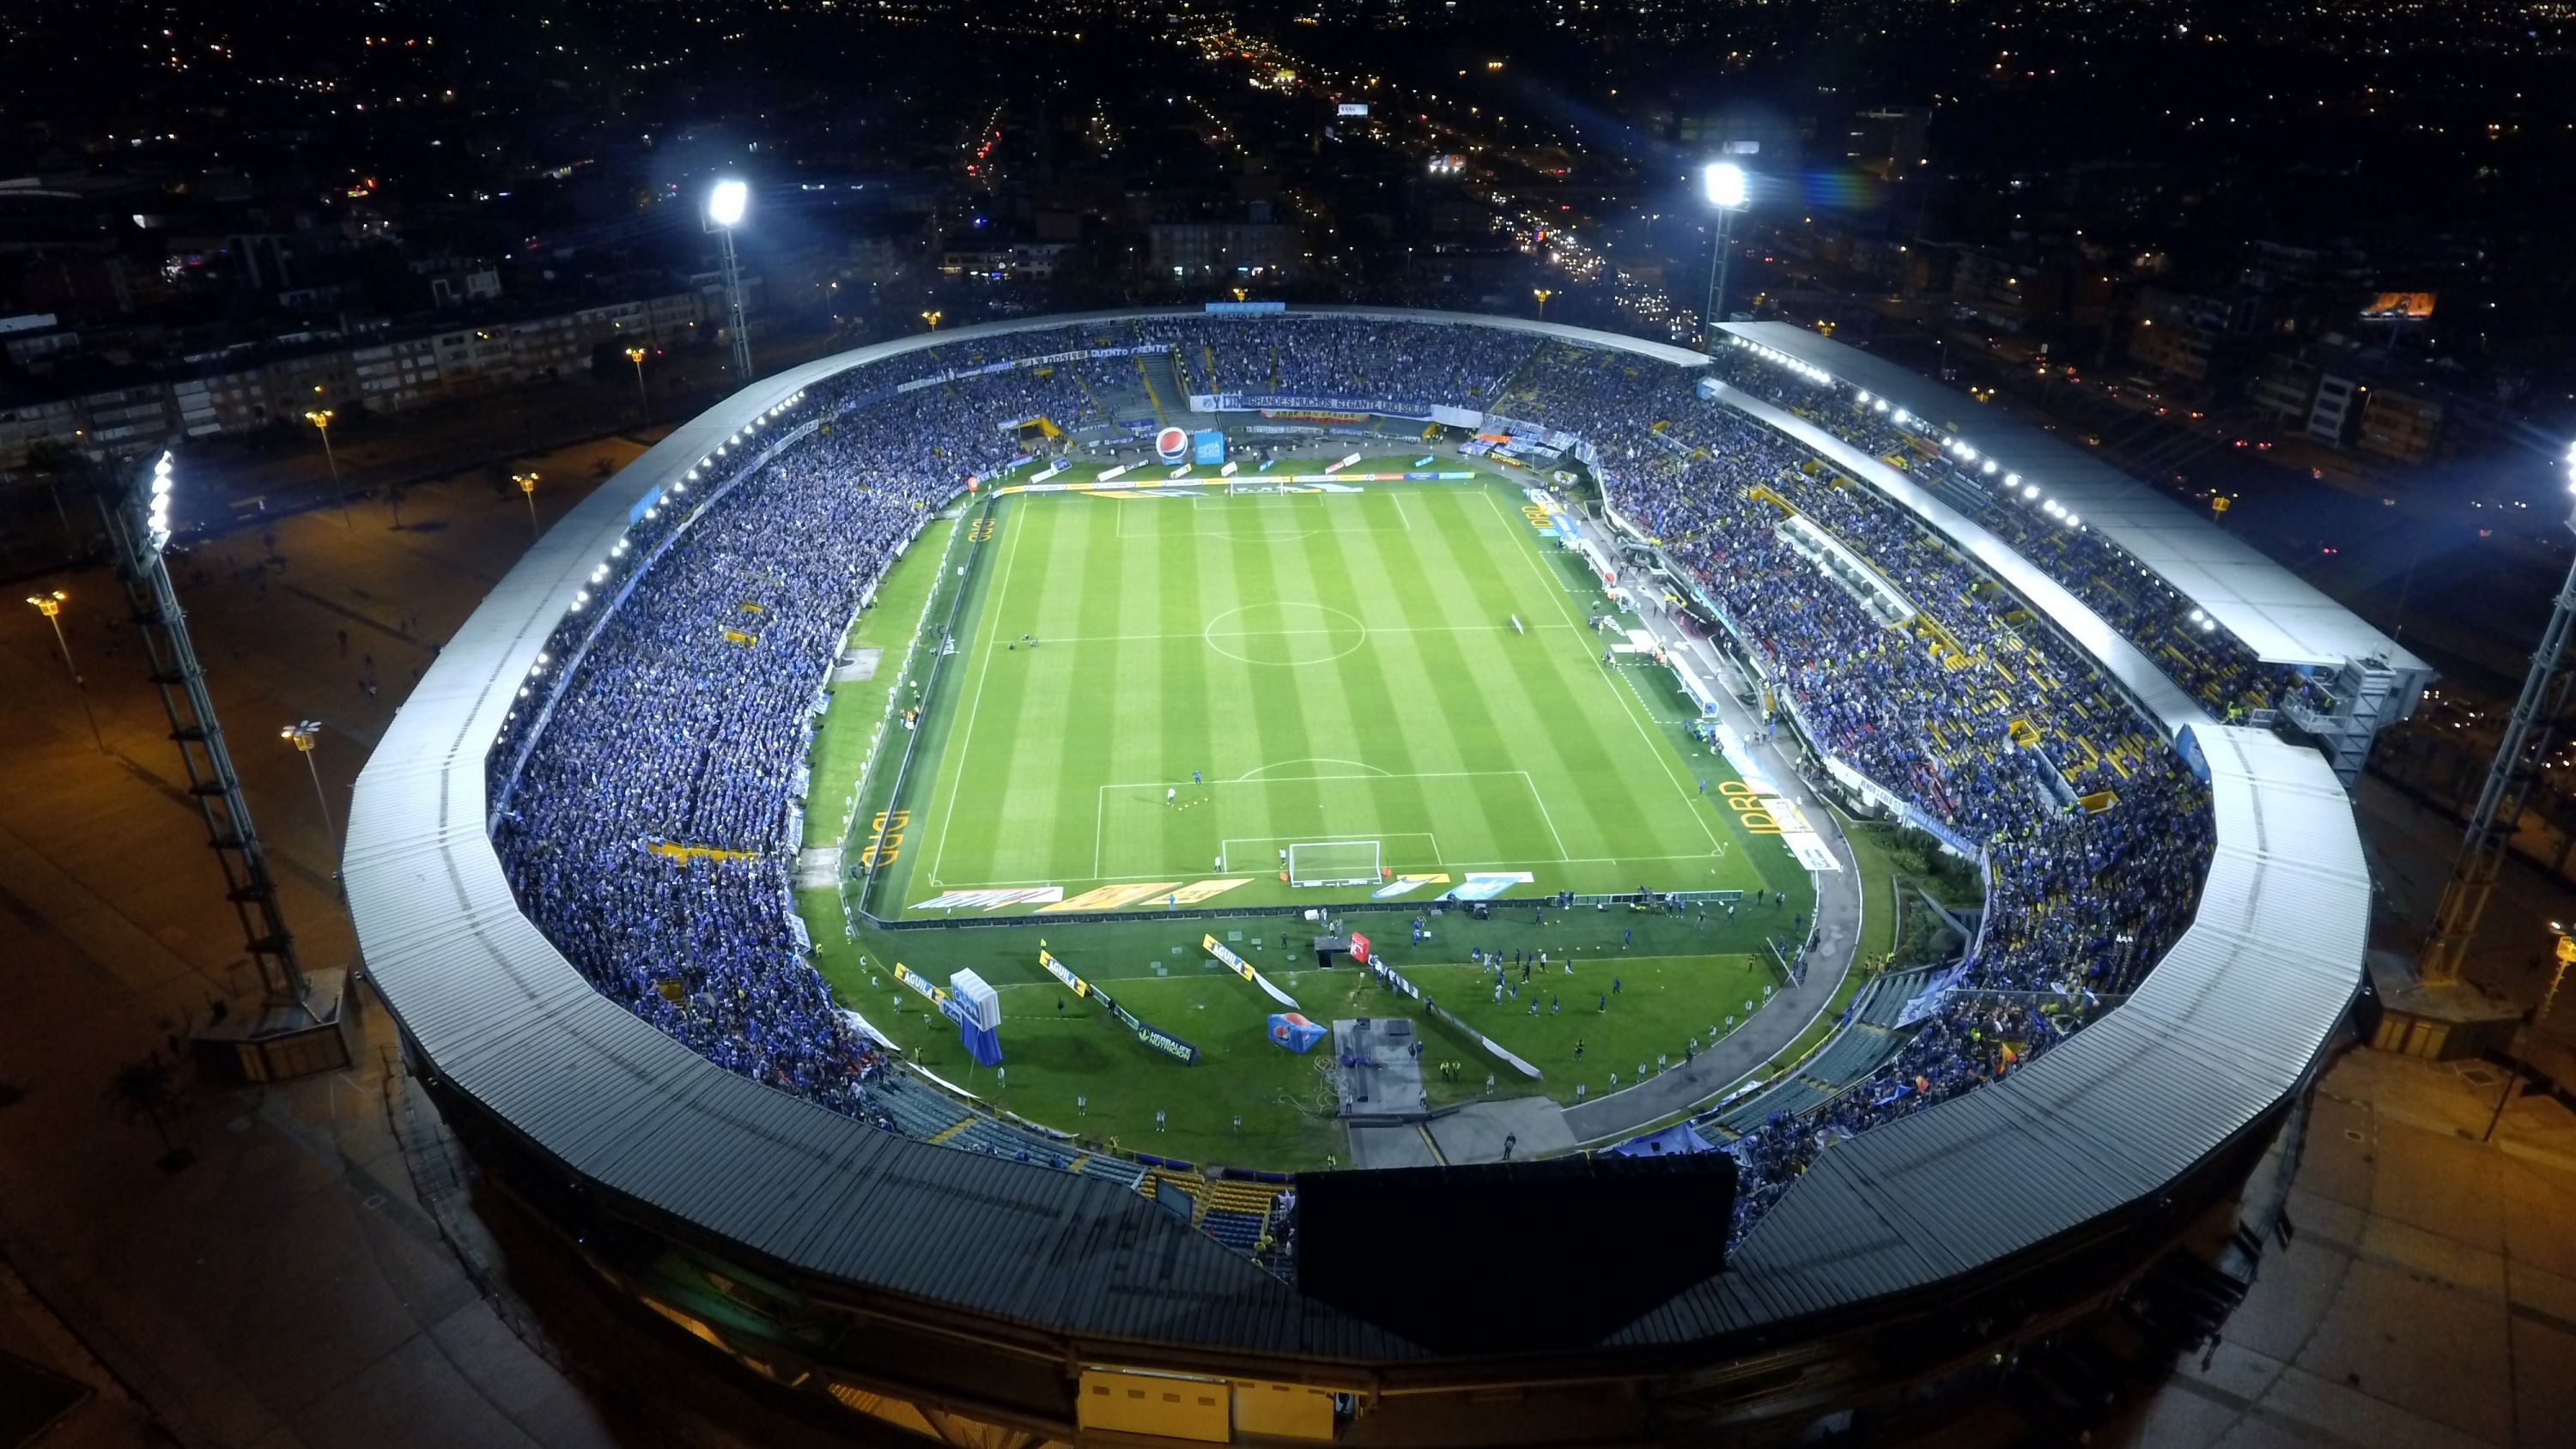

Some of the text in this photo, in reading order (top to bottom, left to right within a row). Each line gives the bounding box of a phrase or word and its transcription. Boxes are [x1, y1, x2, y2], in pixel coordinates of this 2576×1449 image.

[1091, 344, 1169, 359] QUINTO FRENTE
[1249, 396, 1294, 407] GRANDES
[1295, 397, 1332, 409] MUCHOS
[1336, 398, 1378, 410] GIGANTE
[1381, 401, 1400, 413] UNO
[1718, 780, 1781, 834] IDRD
[861, 810, 911, 867] IDRD
[1149, 1037, 1191, 1061] NUTRICION
[1151, 1032, 1192, 1055] HERBALIFE
